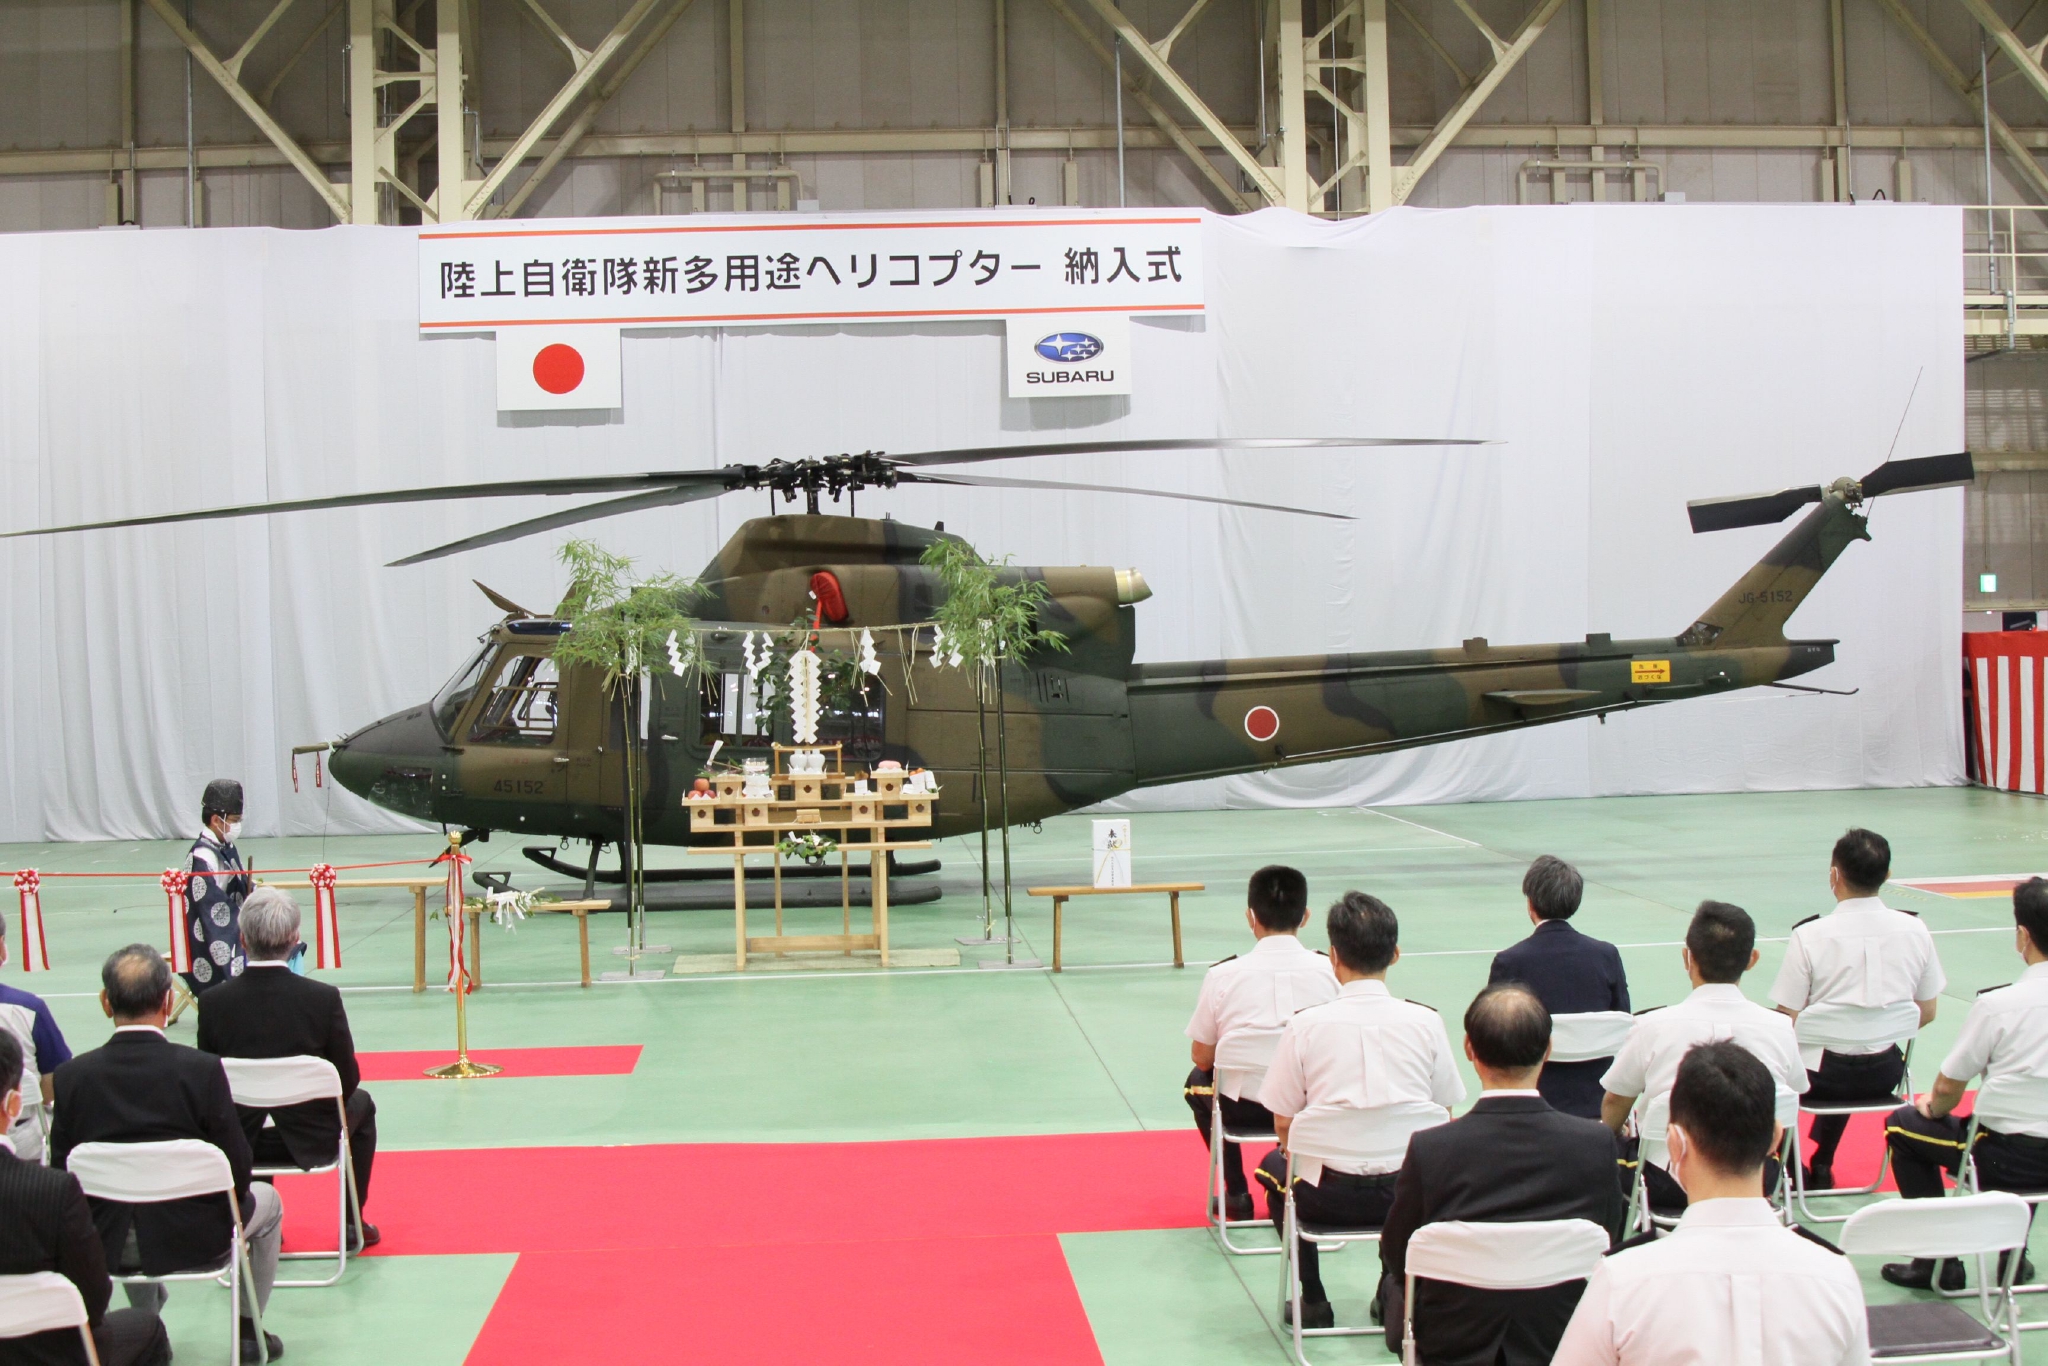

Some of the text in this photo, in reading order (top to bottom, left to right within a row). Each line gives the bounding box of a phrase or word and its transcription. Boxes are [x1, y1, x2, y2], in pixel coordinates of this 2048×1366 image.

[440, 245, 1182, 299] 陸上自衛隊新多用途ヘリコプター 納入式
[1026, 369, 1115, 385] SUBARU
[1738, 590, 1793, 604] JG-5152
[493, 779, 544, 795] 45152
